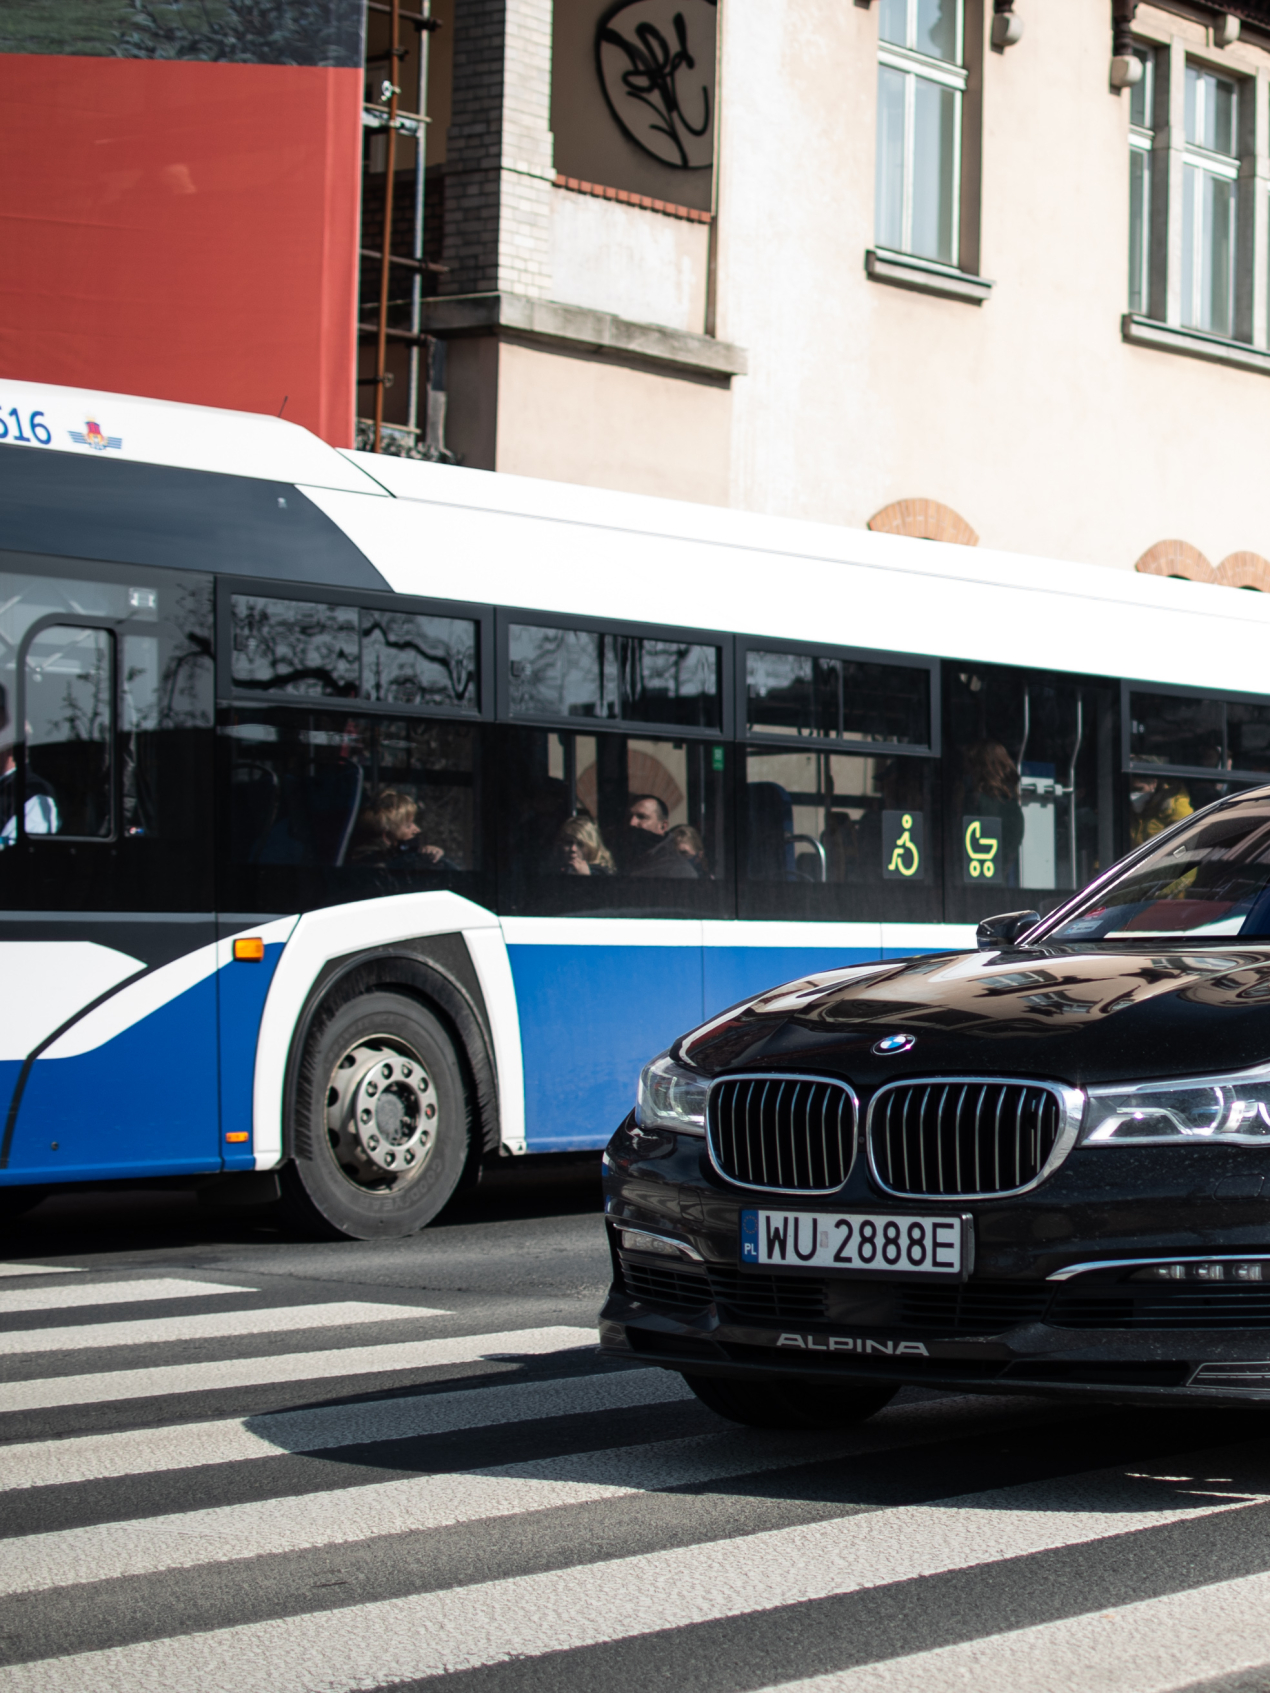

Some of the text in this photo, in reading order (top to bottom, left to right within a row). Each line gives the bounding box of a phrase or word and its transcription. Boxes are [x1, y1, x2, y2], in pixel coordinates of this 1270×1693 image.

[744, 1215, 955, 1268] PL WU 2888E
[776, 1333, 930, 1356] ALPINA
